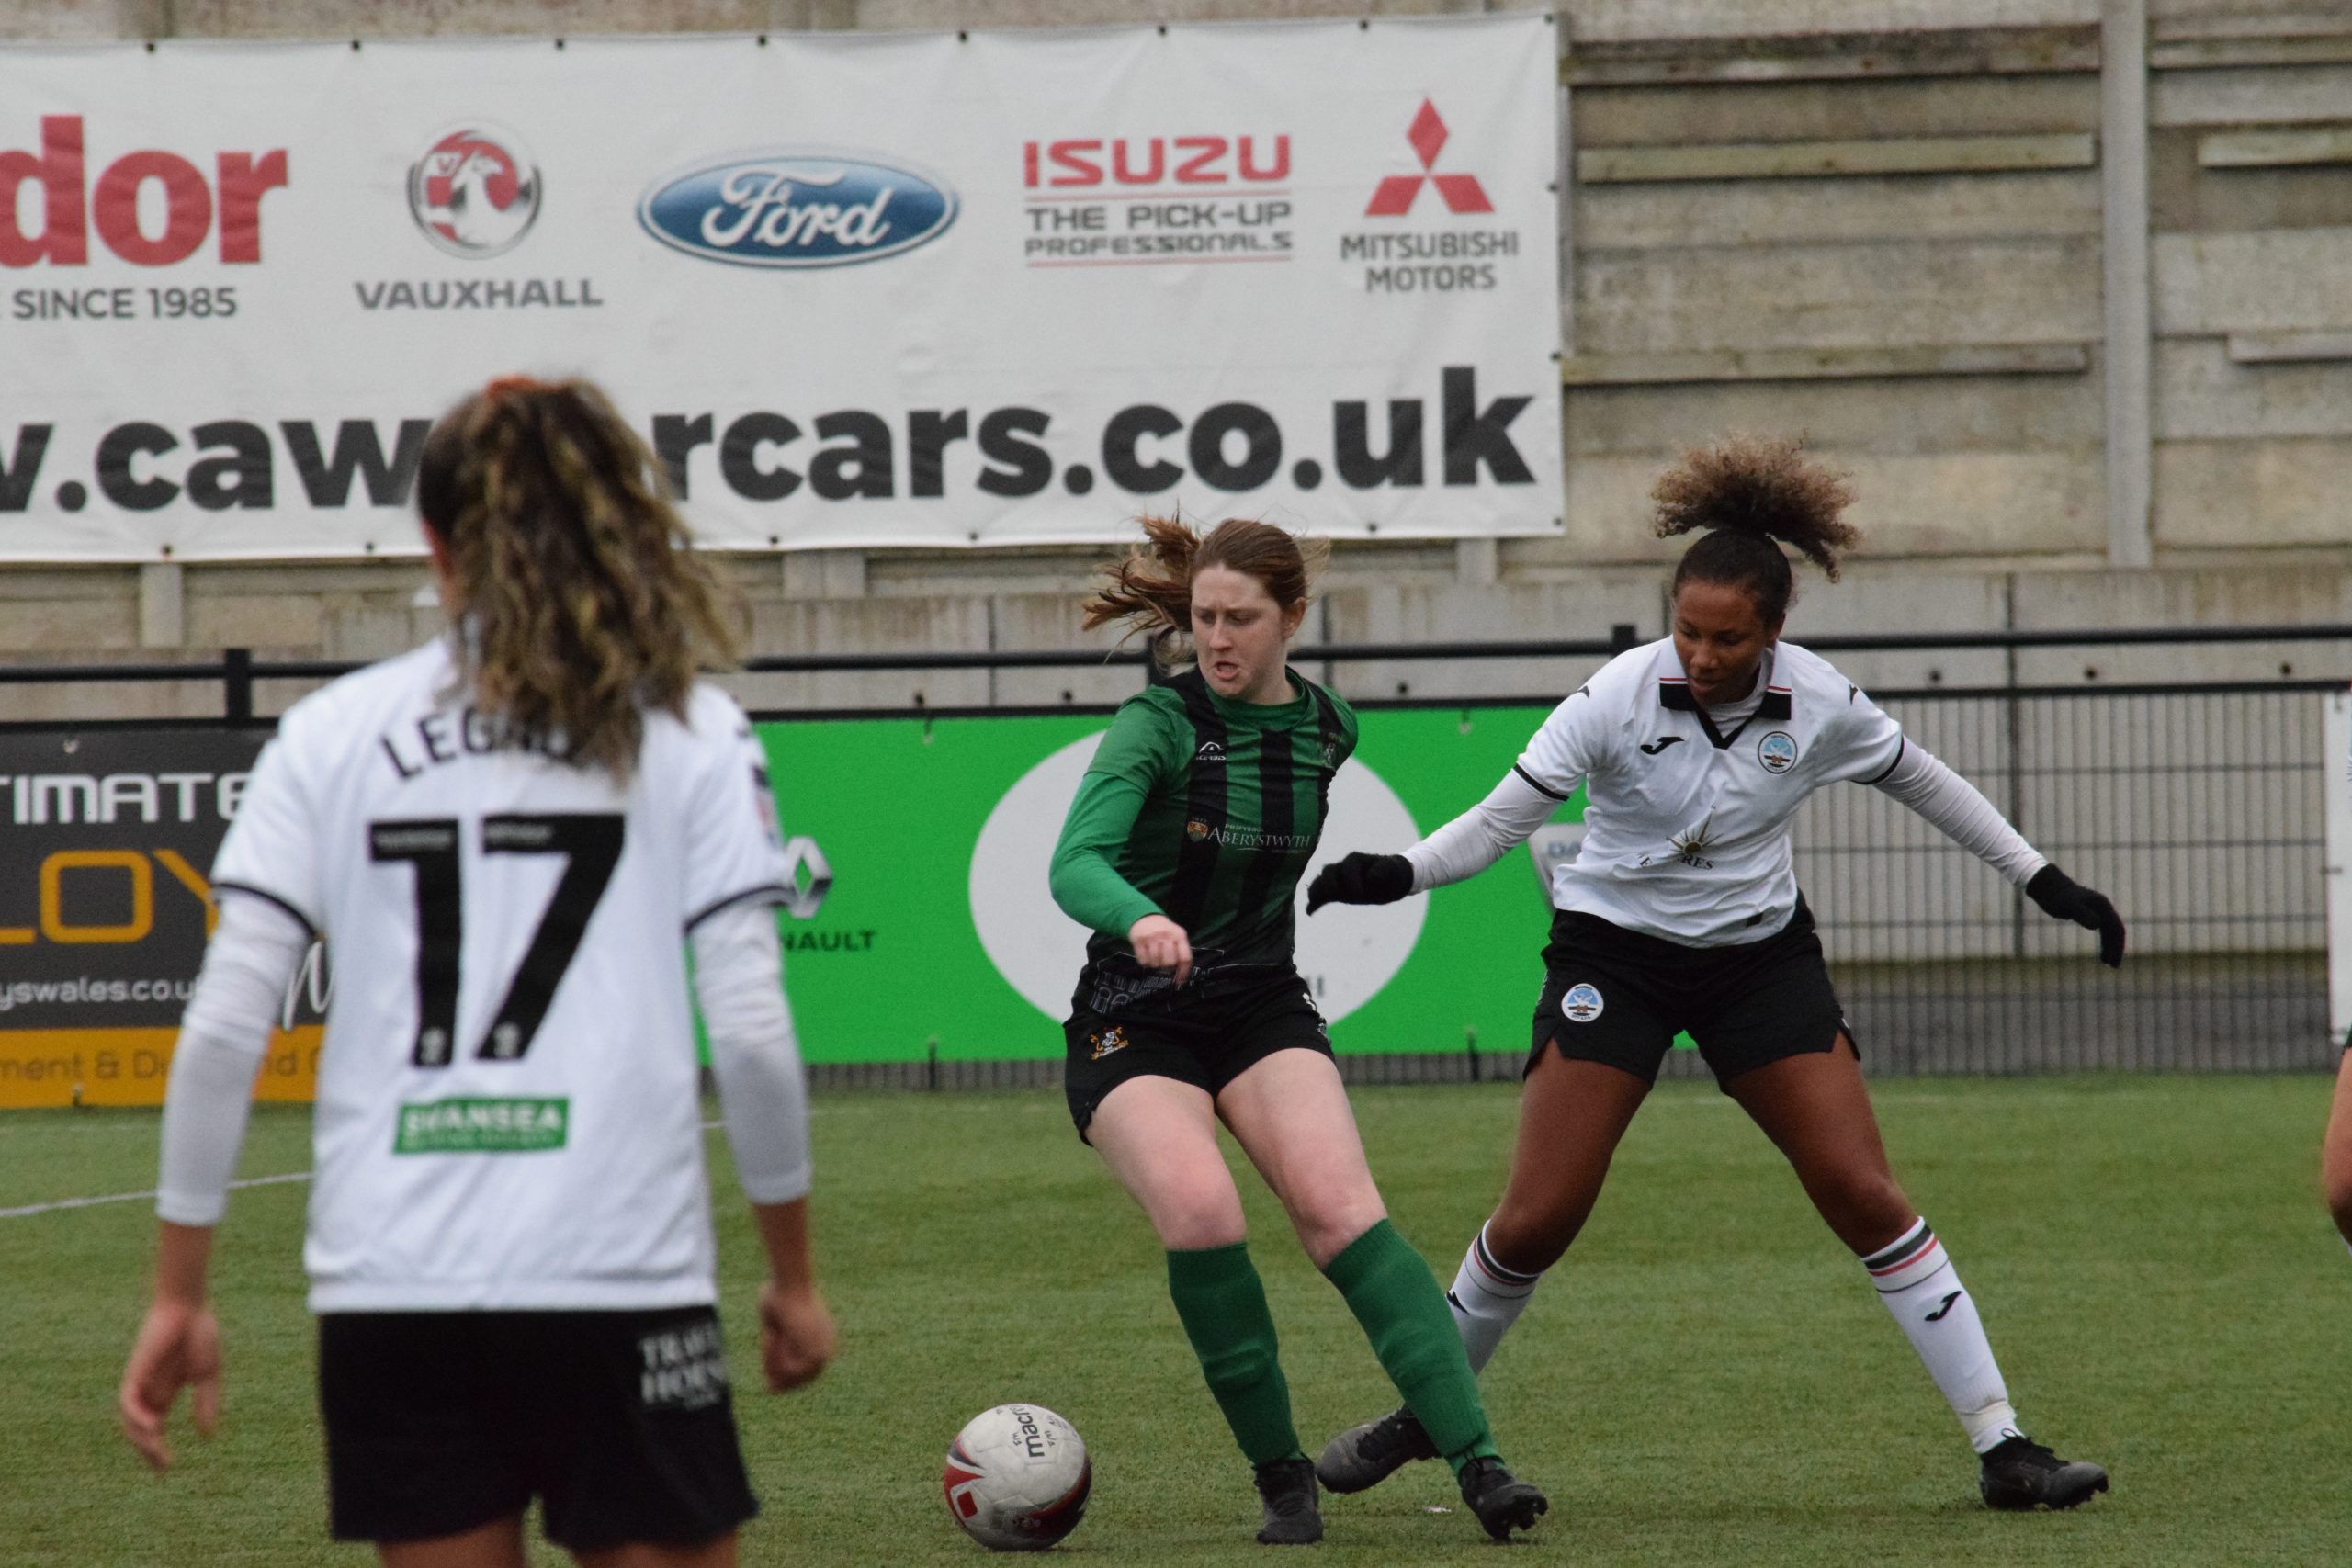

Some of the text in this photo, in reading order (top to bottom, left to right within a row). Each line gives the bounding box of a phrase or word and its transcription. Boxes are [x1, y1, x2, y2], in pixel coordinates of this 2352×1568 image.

[1023, 134, 1292, 187] ISUZU
[700, 168, 894, 247] Ford
[1024, 200, 1292, 231] THE PICK-UP
[1024, 231, 1293, 257] PROFESSIONALS
[1340, 231, 1519, 261] MITSUBISHI
[355, 278, 604, 310] VAUXHALL
[1366, 264, 1497, 293] MOTORS
[13, 287, 237, 320] SINCE 1985
[1208, 827, 1311, 847] ABERYSTWYTH
[368, 813, 626, 1067] 17
